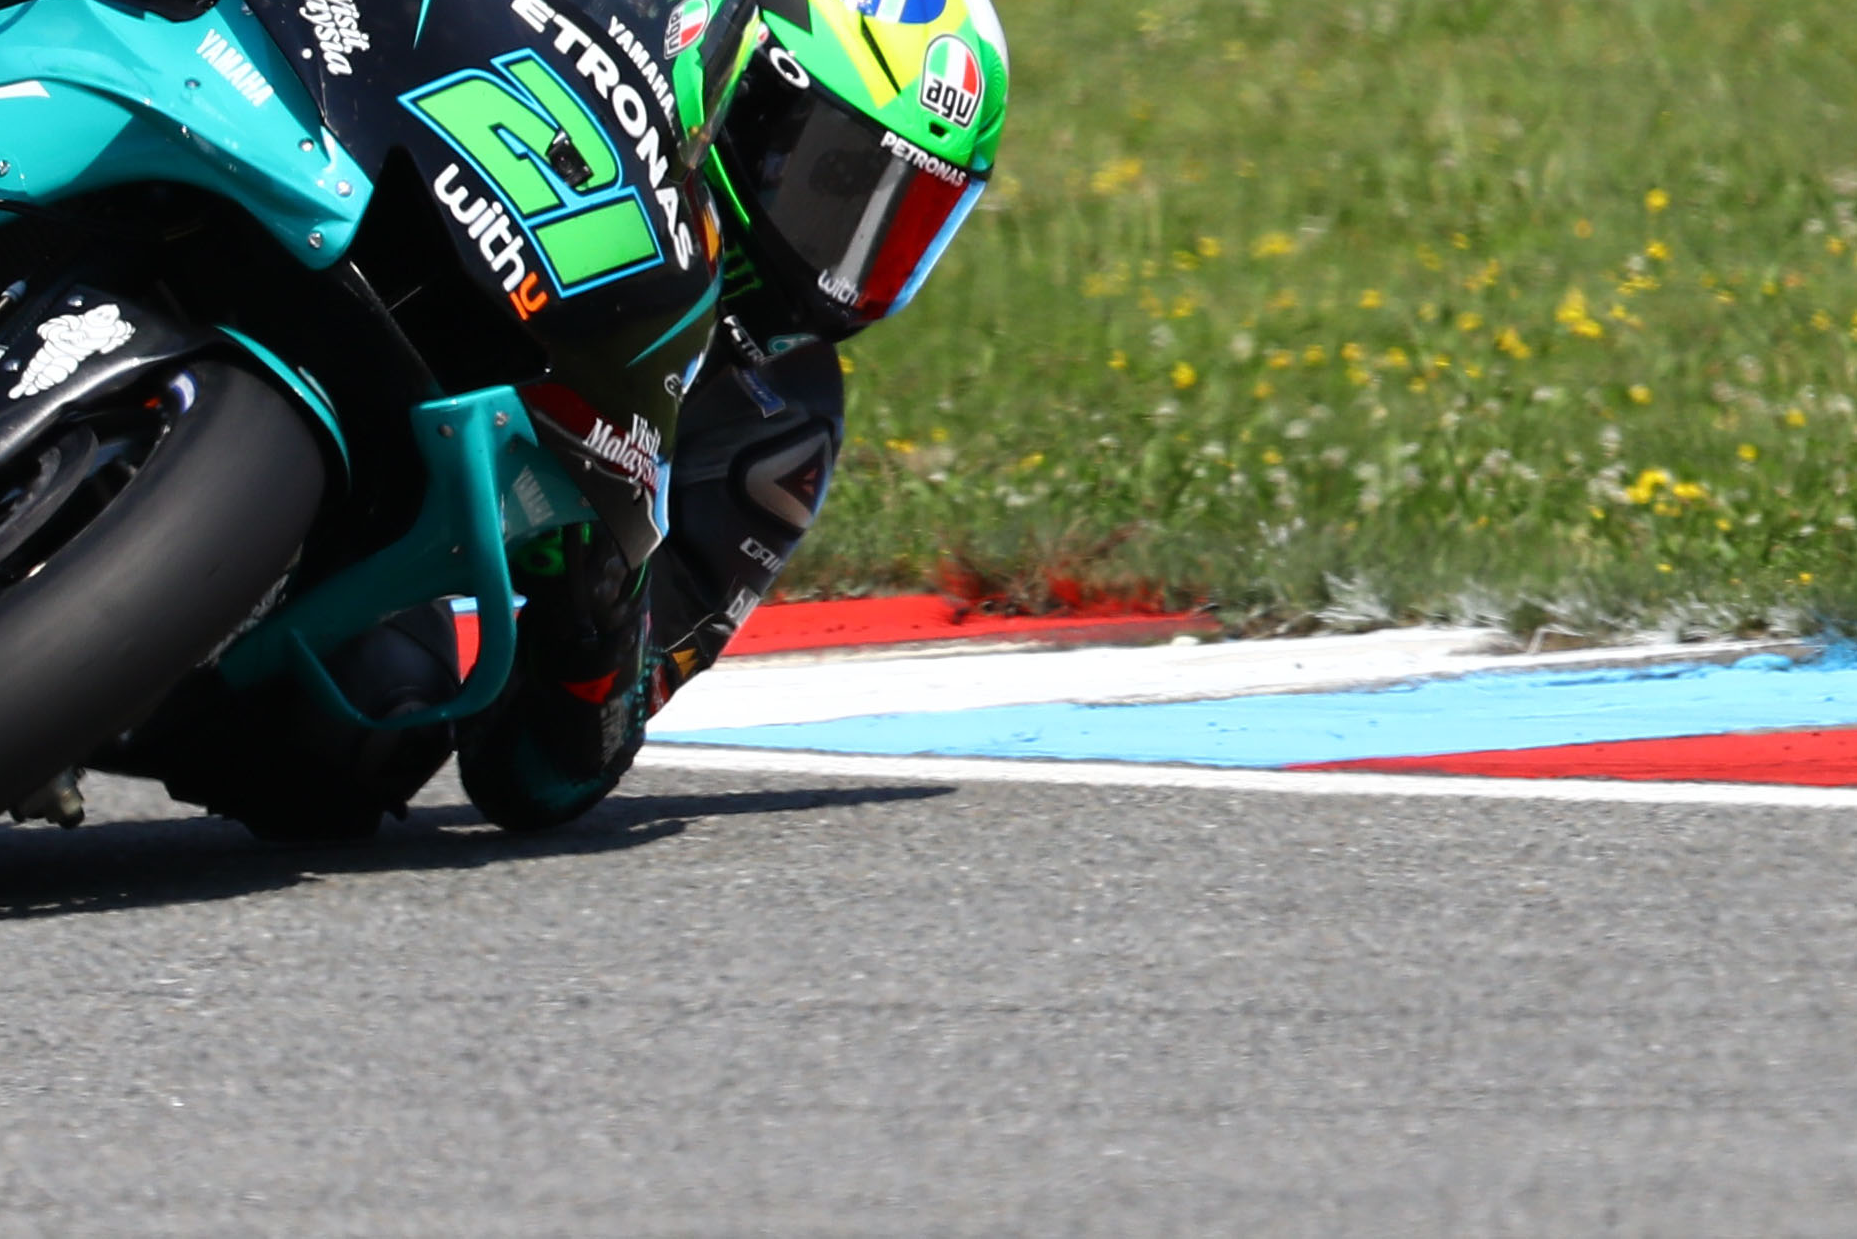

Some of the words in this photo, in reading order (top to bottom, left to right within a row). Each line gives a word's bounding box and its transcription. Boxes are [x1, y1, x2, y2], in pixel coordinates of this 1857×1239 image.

[196, 28, 274, 107] YAMAHA
[608, 15, 676, 121] YAMAHA
[926, 78, 972, 120] agv
[397, 47, 665, 299] 21
[880, 130, 967, 187] PETRONAS
[434, 163, 549, 321] withu
